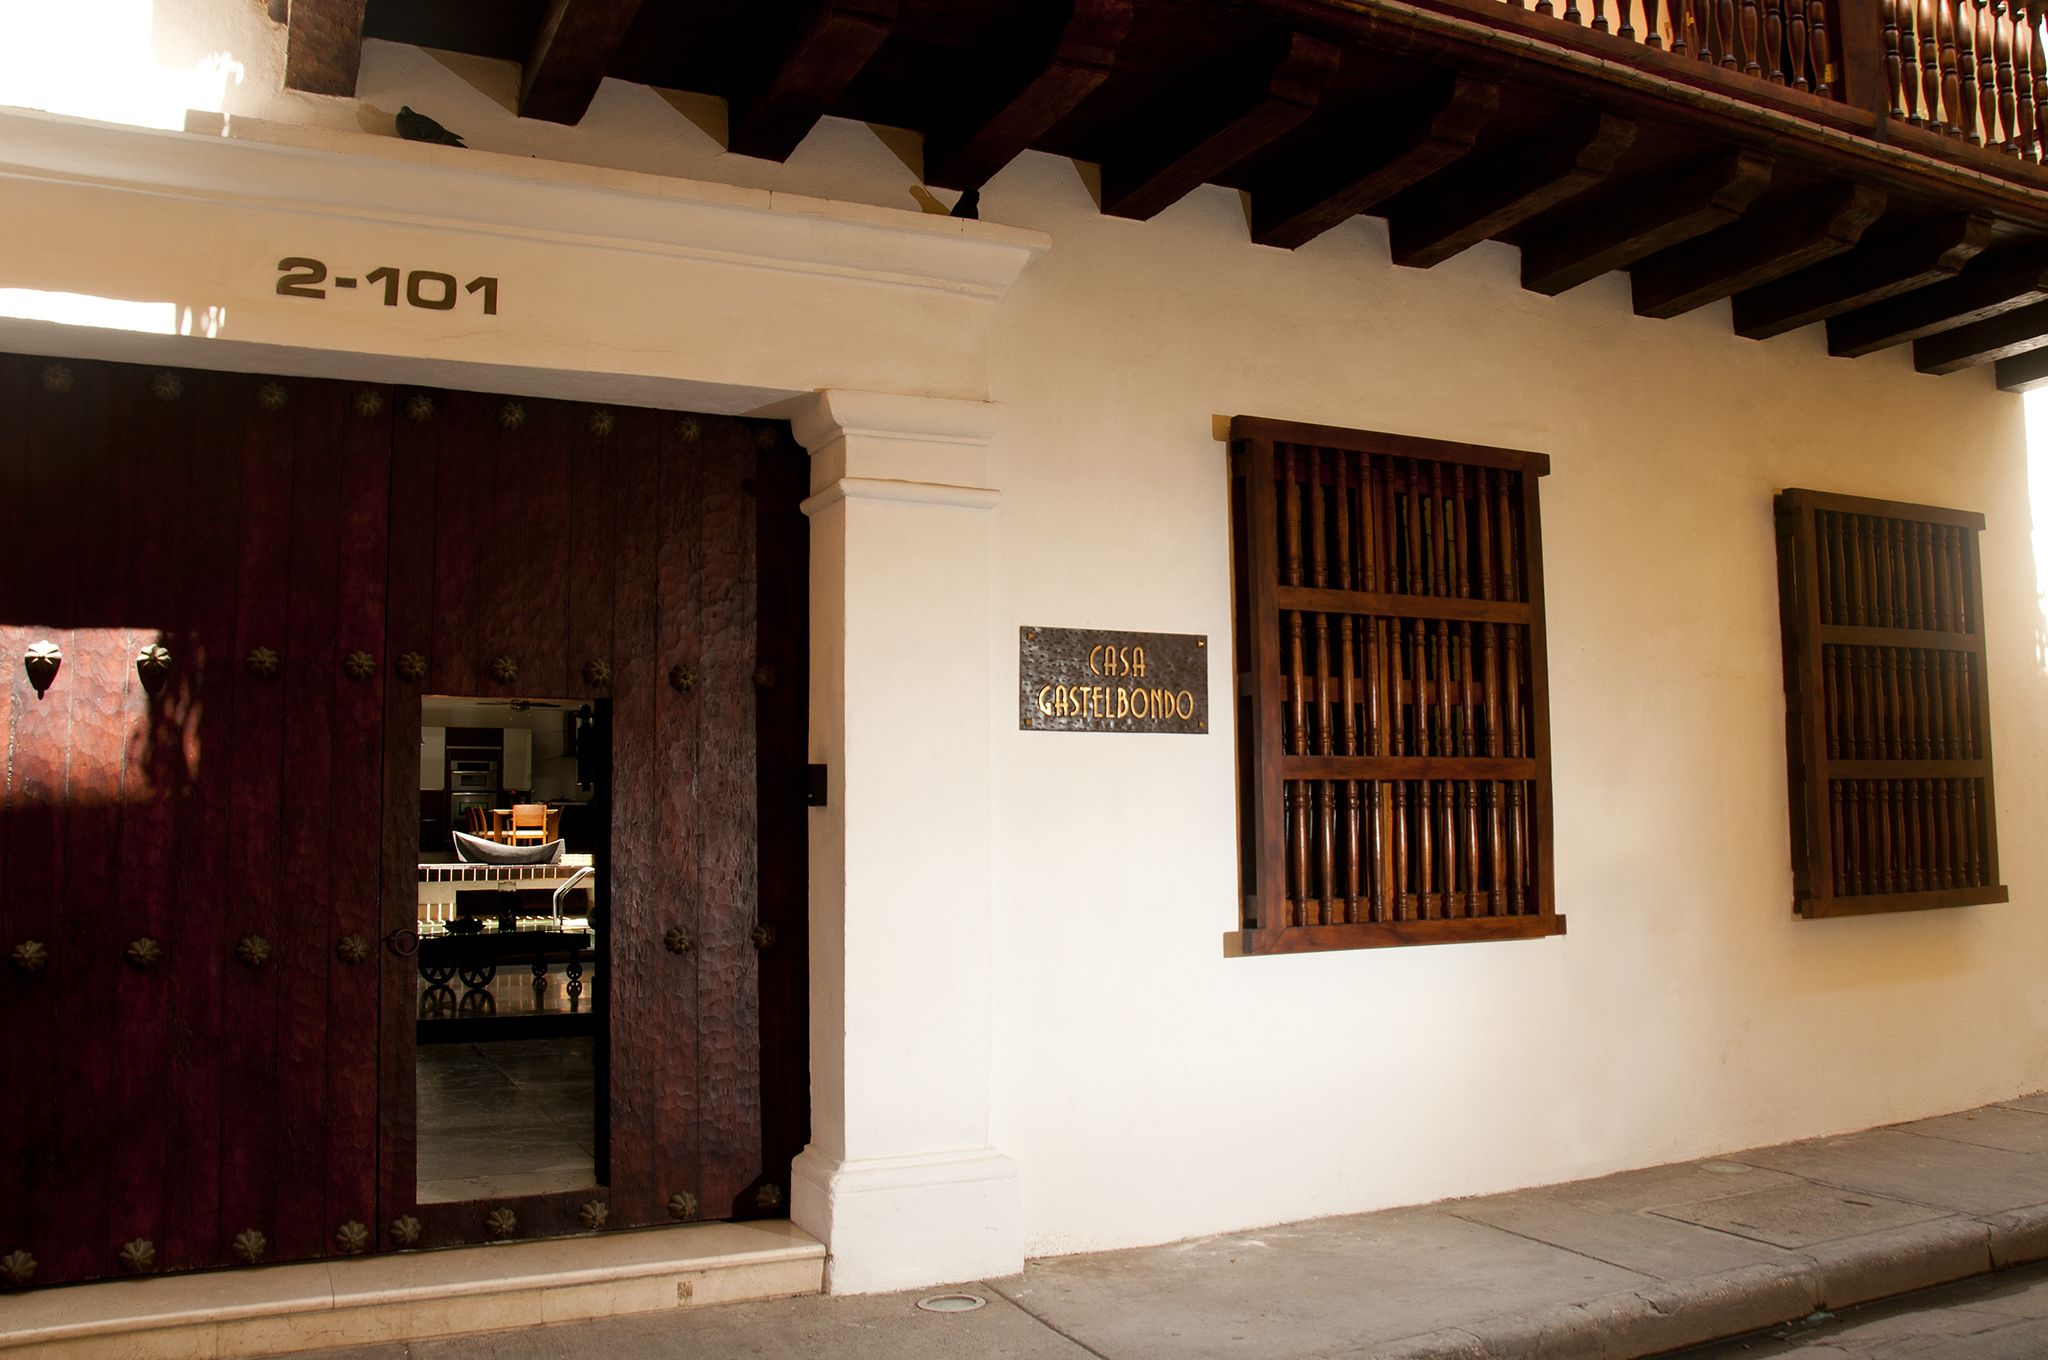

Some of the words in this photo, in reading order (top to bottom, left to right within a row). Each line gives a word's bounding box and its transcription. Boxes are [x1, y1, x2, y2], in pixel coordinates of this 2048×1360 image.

[276, 256, 498, 315] 2-101
[1089, 644, 1146, 678] CASA
[1038, 684, 1195, 720] GASTELBONDO
